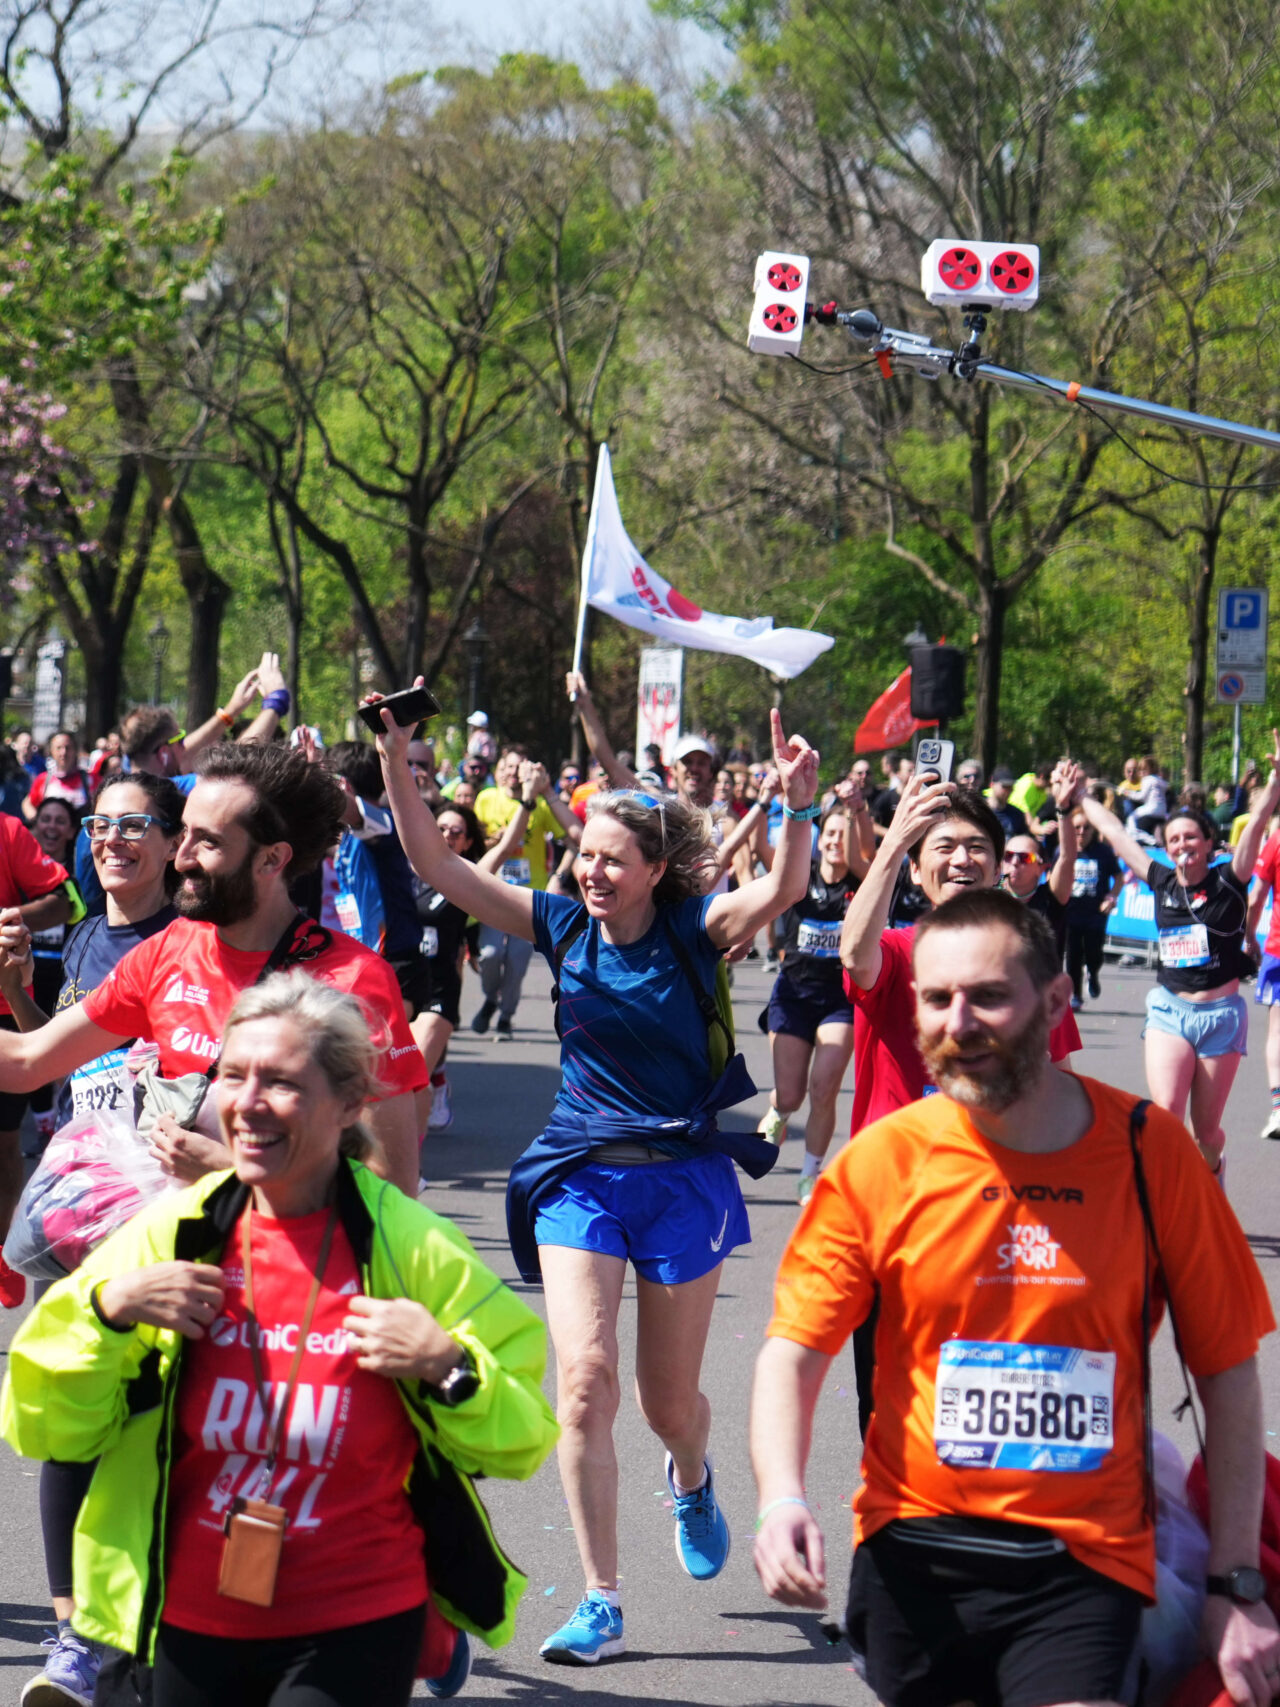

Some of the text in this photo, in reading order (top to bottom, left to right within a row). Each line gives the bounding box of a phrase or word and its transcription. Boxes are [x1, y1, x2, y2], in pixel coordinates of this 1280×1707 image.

[1233, 598, 1254, 626] P
[982, 1185, 1083, 1205] GIVOVA
[1007, 1224, 1050, 1248] YOU
[997, 1242, 1062, 1270] SPORT
[240, 1322, 352, 1355] UniCedi
[202, 1377, 340, 1467] RUN
[331, 1426, 345, 1459] APRIL
[338, 1386, 352, 1422] 2025
[964, 1388, 1087, 1441] 3658C
